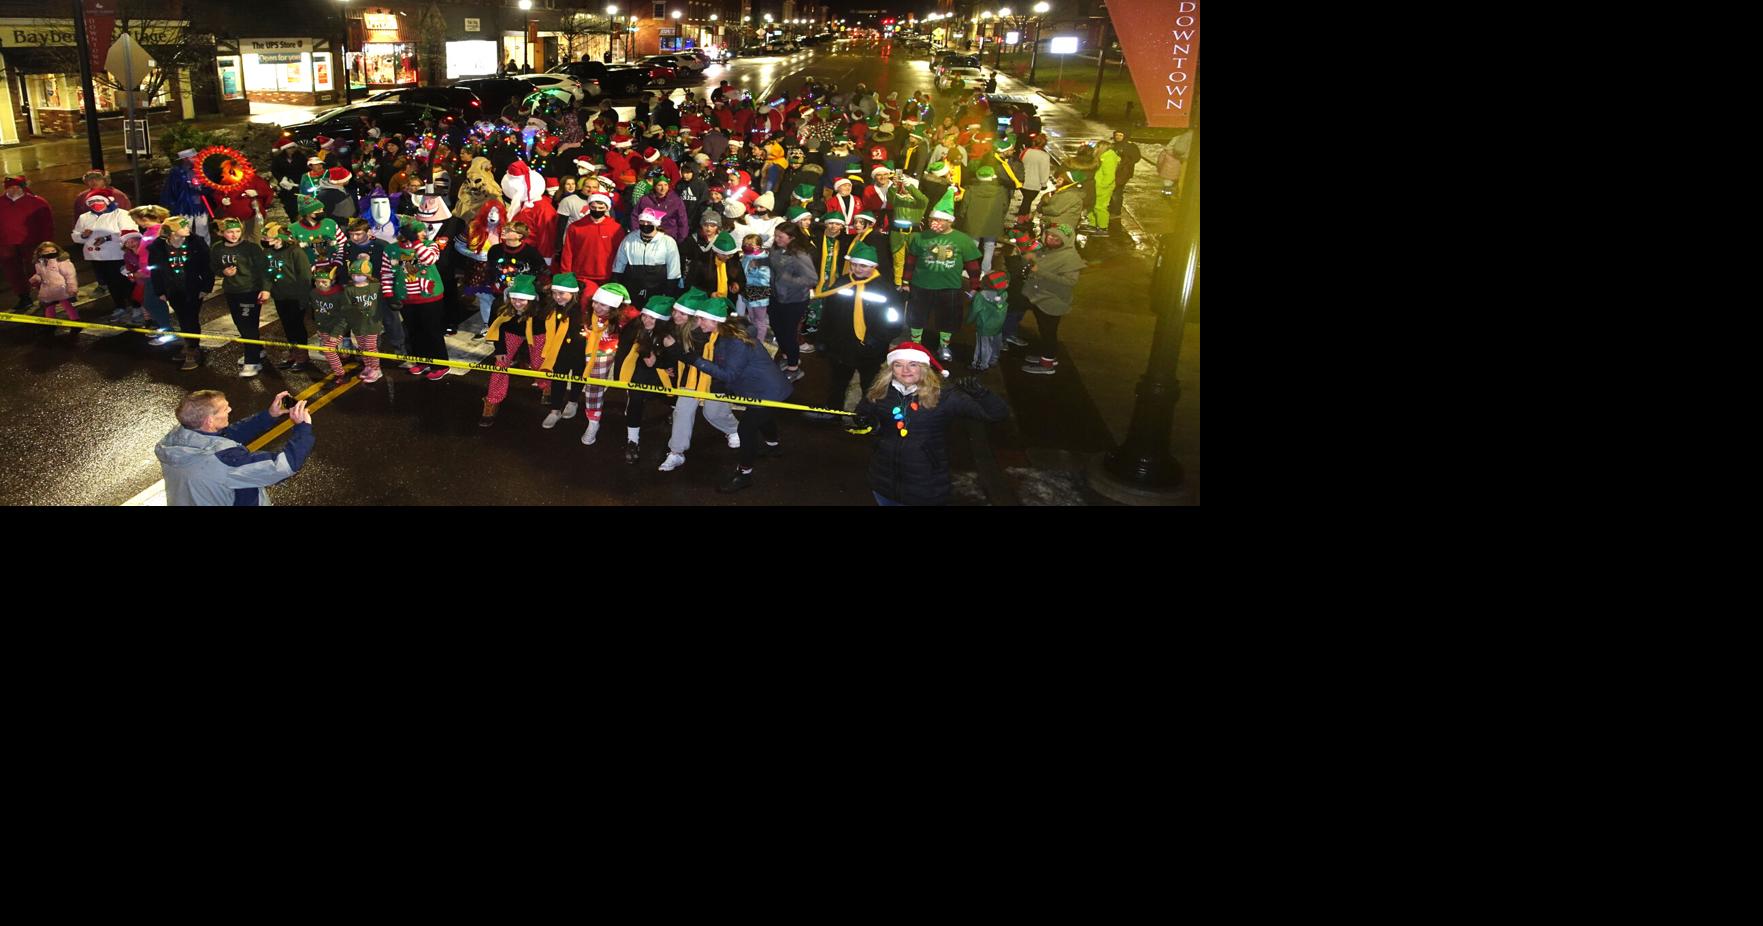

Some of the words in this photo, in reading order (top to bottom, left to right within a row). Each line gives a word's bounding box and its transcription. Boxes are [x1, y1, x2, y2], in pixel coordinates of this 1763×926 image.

[252, 41, 265, 50] The
[266, 41, 279, 49] UPS
[280, 40, 297, 49] Store
[1165, 2, 1196, 110] DOWNTOWN
[468, 362, 508, 372] CAUTION
[545, 371, 587, 382] CAUTION
[628, 382, 672, 392] CAUTION
